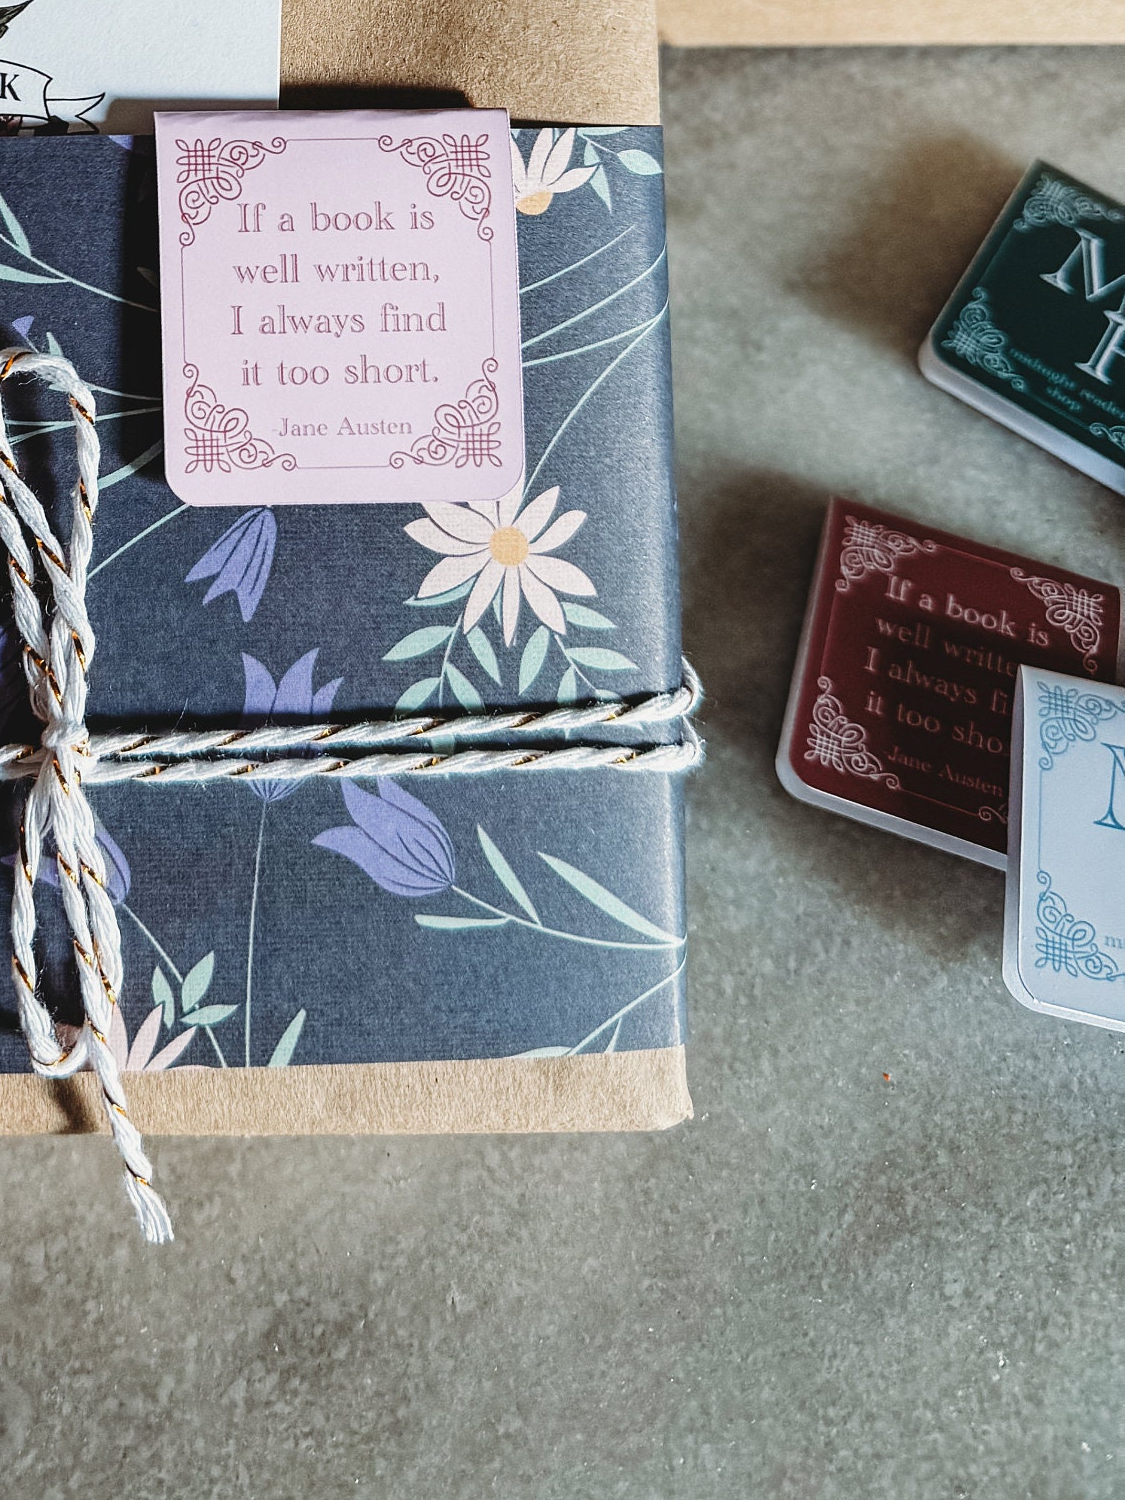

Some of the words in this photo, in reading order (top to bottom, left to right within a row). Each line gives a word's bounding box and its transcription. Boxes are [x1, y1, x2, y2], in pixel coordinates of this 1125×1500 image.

[236, 202, 266, 233] If
[277, 212, 295, 232] a
[310, 202, 395, 232] book
[409, 203, 435, 230] is
[233, 254, 299, 284] well
[313, 256, 440, 284] written,
[230, 305, 243, 335] I
[259, 304, 365, 338] always
[379, 302, 447, 333] find
[241, 360, 262, 386] it
[277, 360, 329, 385] too
[344, 355, 439, 384] short.
[337, 416, 412, 437] Austen
[885, 575, 913, 602] If
[919, 593, 934, 612] a
[946, 593, 1016, 637] book
[1027, 622, 1049, 646] is
[875, 617, 930, 648] well
[943, 640, 1016, 678] writte
[863, 646, 879, 671] I
[888, 660, 977, 704] always
[864, 690, 883, 716] it
[898, 703, 940, 733] too
[952, 721, 1010, 756] sho
[939, 763, 1003, 797] Austen
